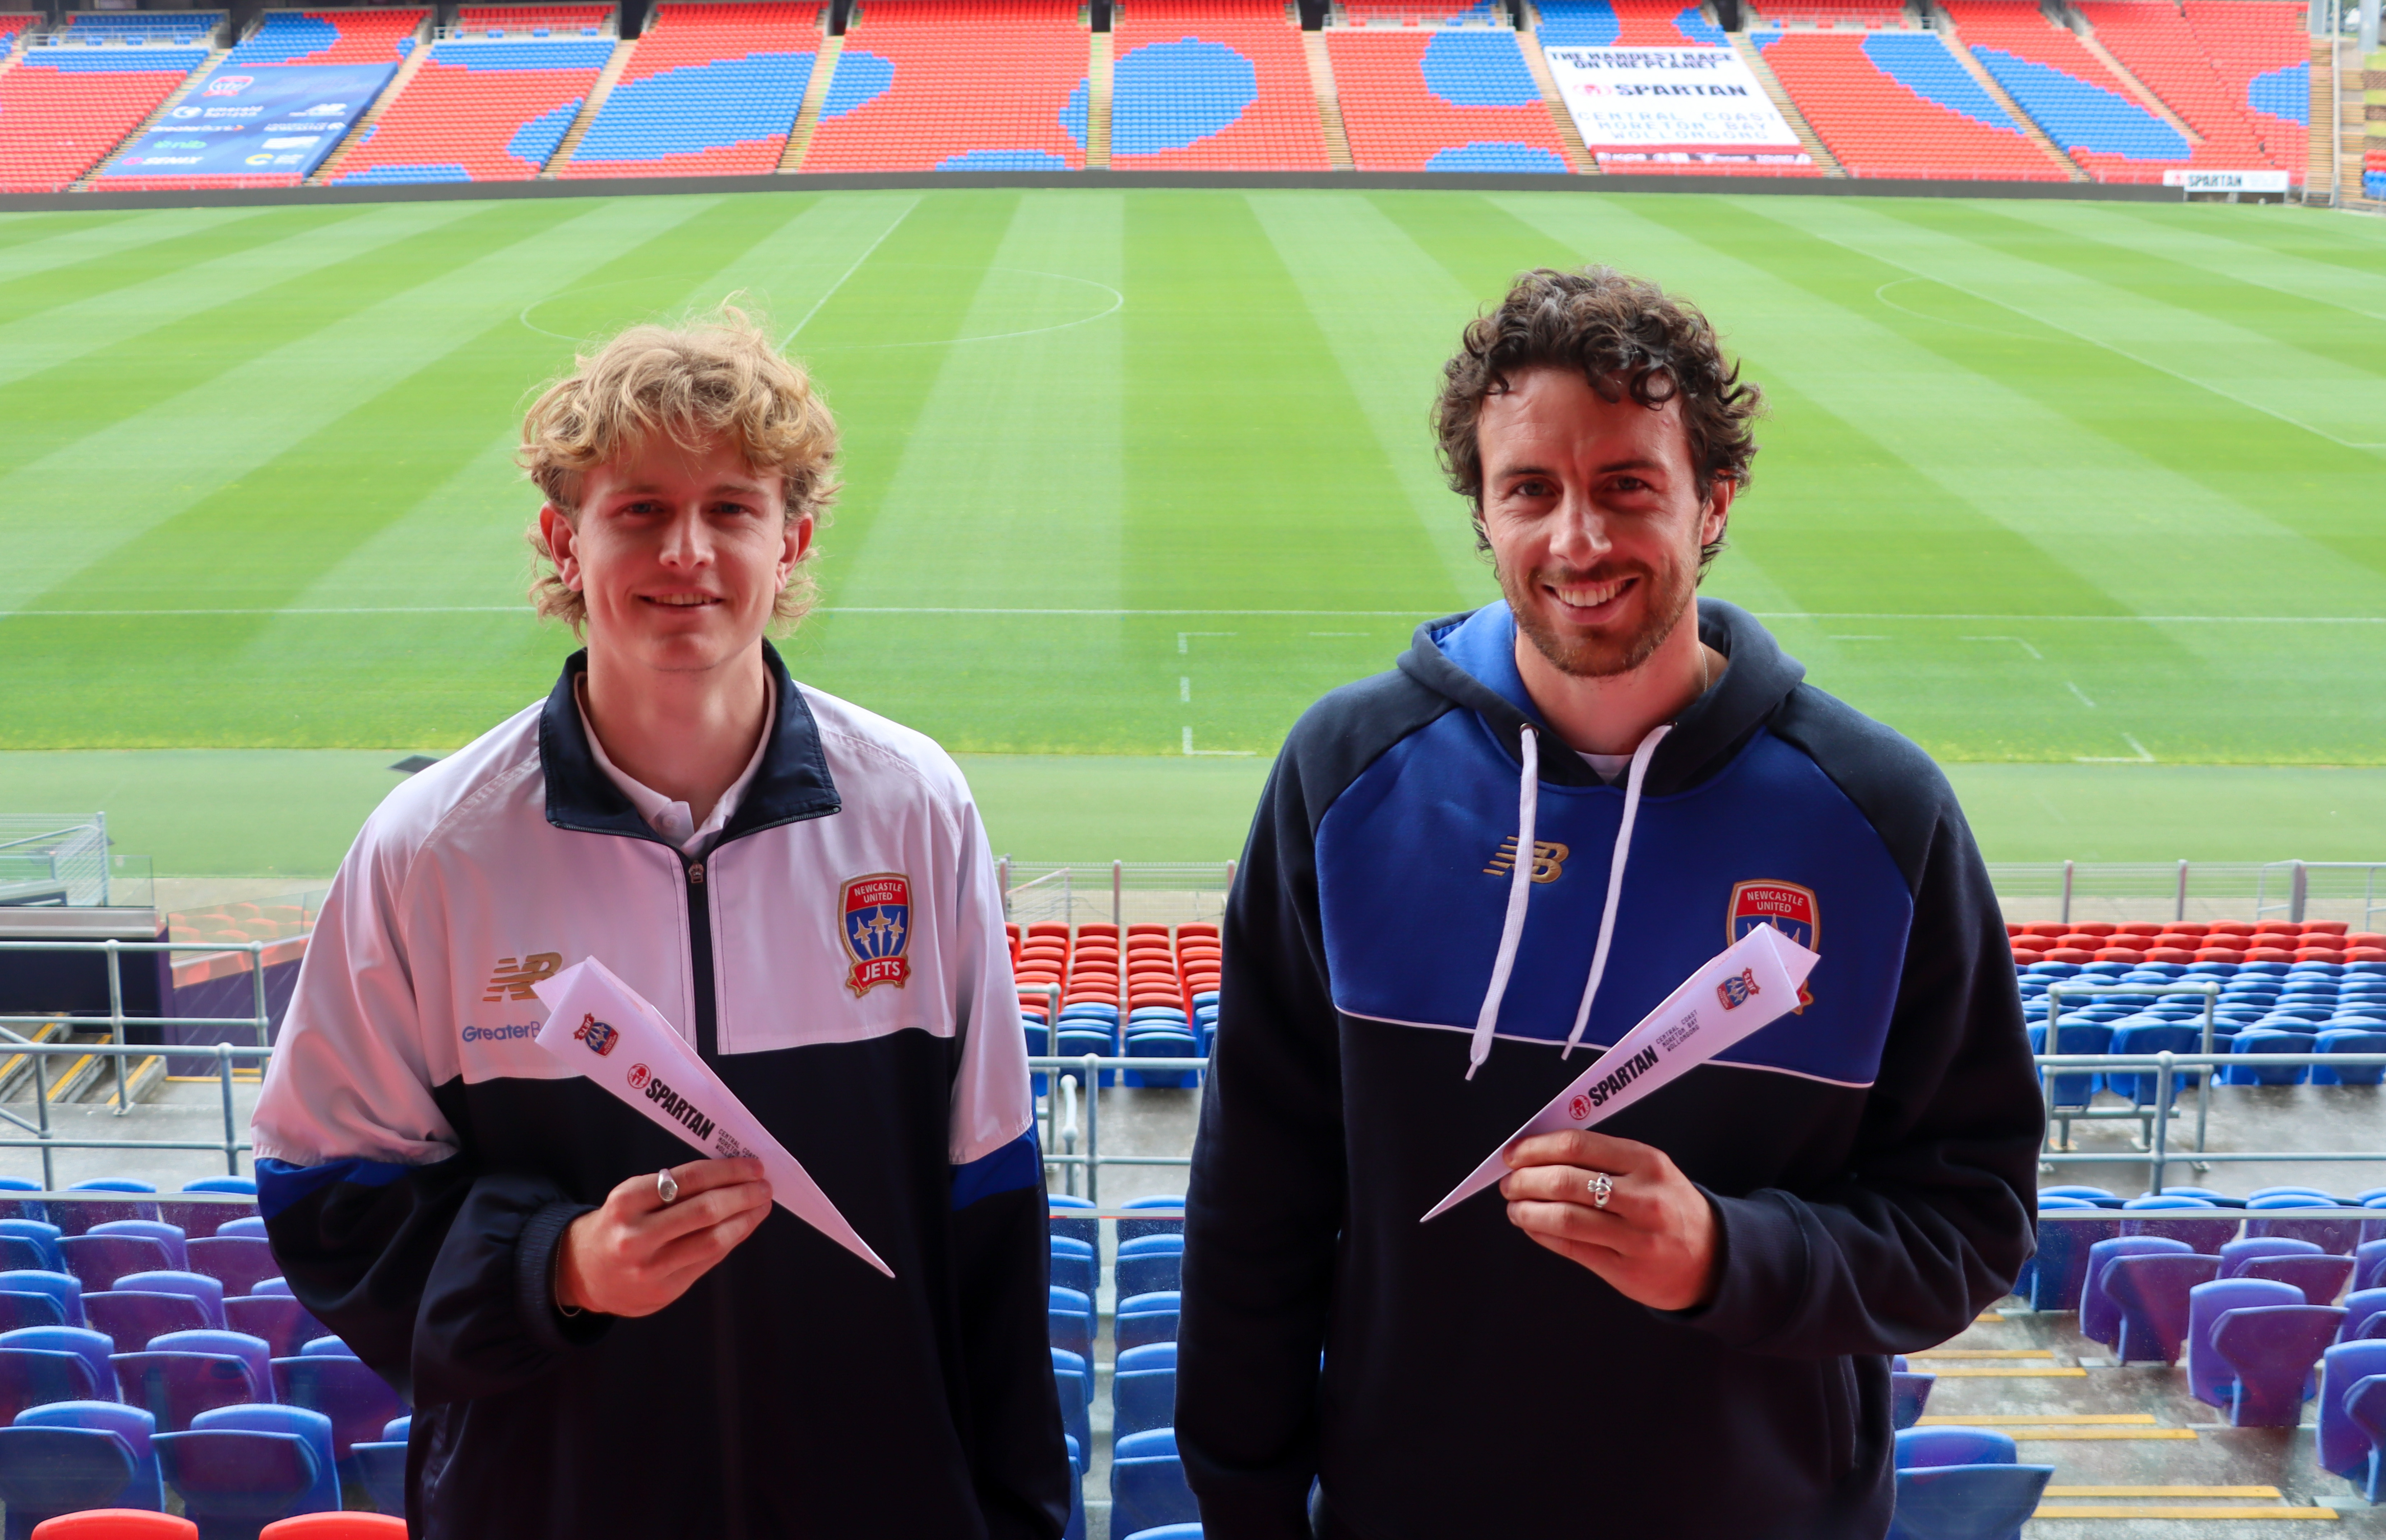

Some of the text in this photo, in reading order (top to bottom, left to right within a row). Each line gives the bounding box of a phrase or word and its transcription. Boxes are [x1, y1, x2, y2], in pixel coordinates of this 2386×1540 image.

[1549, 52, 1736, 61] THE HARDEST RACE
[1573, 60, 1718, 69] ON THE PLANET
[1615, 84, 1749, 96] SPARTAN
[1578, 111, 1777, 121] CENTRAL COAST
[1598, 121, 1767, 130] MORETON BAY
[1611, 130, 1769, 139] WOLLONGONG
[2188, 174, 2243, 187] SPARTAN
[854, 882, 902, 896] NEWCASTLE
[863, 892, 893, 903] UNITED
[1747, 891, 1804, 906] NEWCASTLE
[1757, 901, 1792, 913] UNITED
[862, 961, 901, 982] JETS
[1744, 973, 1756, 990] JETS
[462, 1021, 541, 1042] GreaterB
[578, 1018, 592, 1036] JETS
[1656, 1009, 1697, 1044] CENTRAL COAST
[1662, 1017, 1697, 1047] MORETON BAY
[1667, 1024, 1699, 1052] WOLLONGONG
[1588, 1044, 1659, 1107] SPARTAN
[645, 1078, 716, 1141] SPARTAN
[718, 1128, 740, 1149] CENTRAL
[718, 1136, 740, 1156] MORETON
